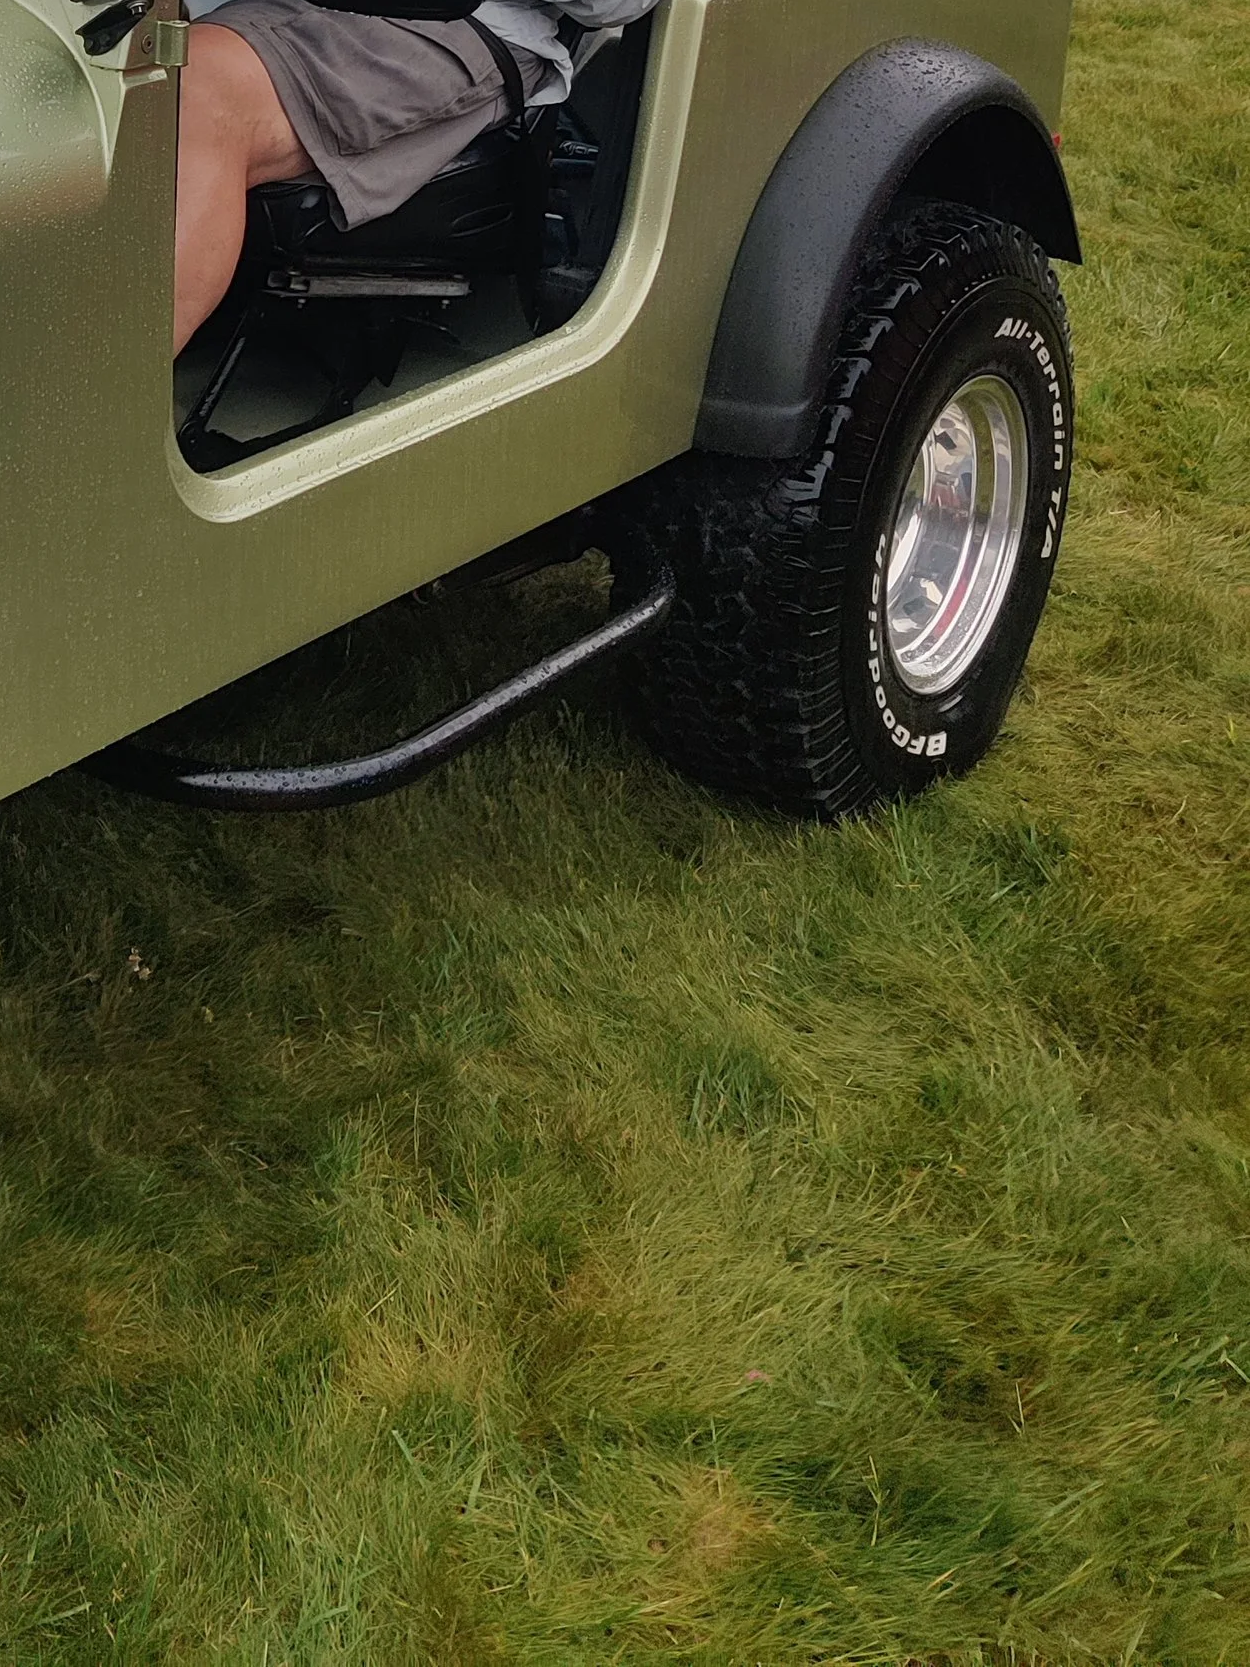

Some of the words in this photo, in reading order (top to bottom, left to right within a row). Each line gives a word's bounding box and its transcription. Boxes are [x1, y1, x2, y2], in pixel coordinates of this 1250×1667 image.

[994, 317, 1066, 472] All-Terrain
[1040, 486, 1064, 560] T/A
[867, 533, 948, 757] BFGoodrich
